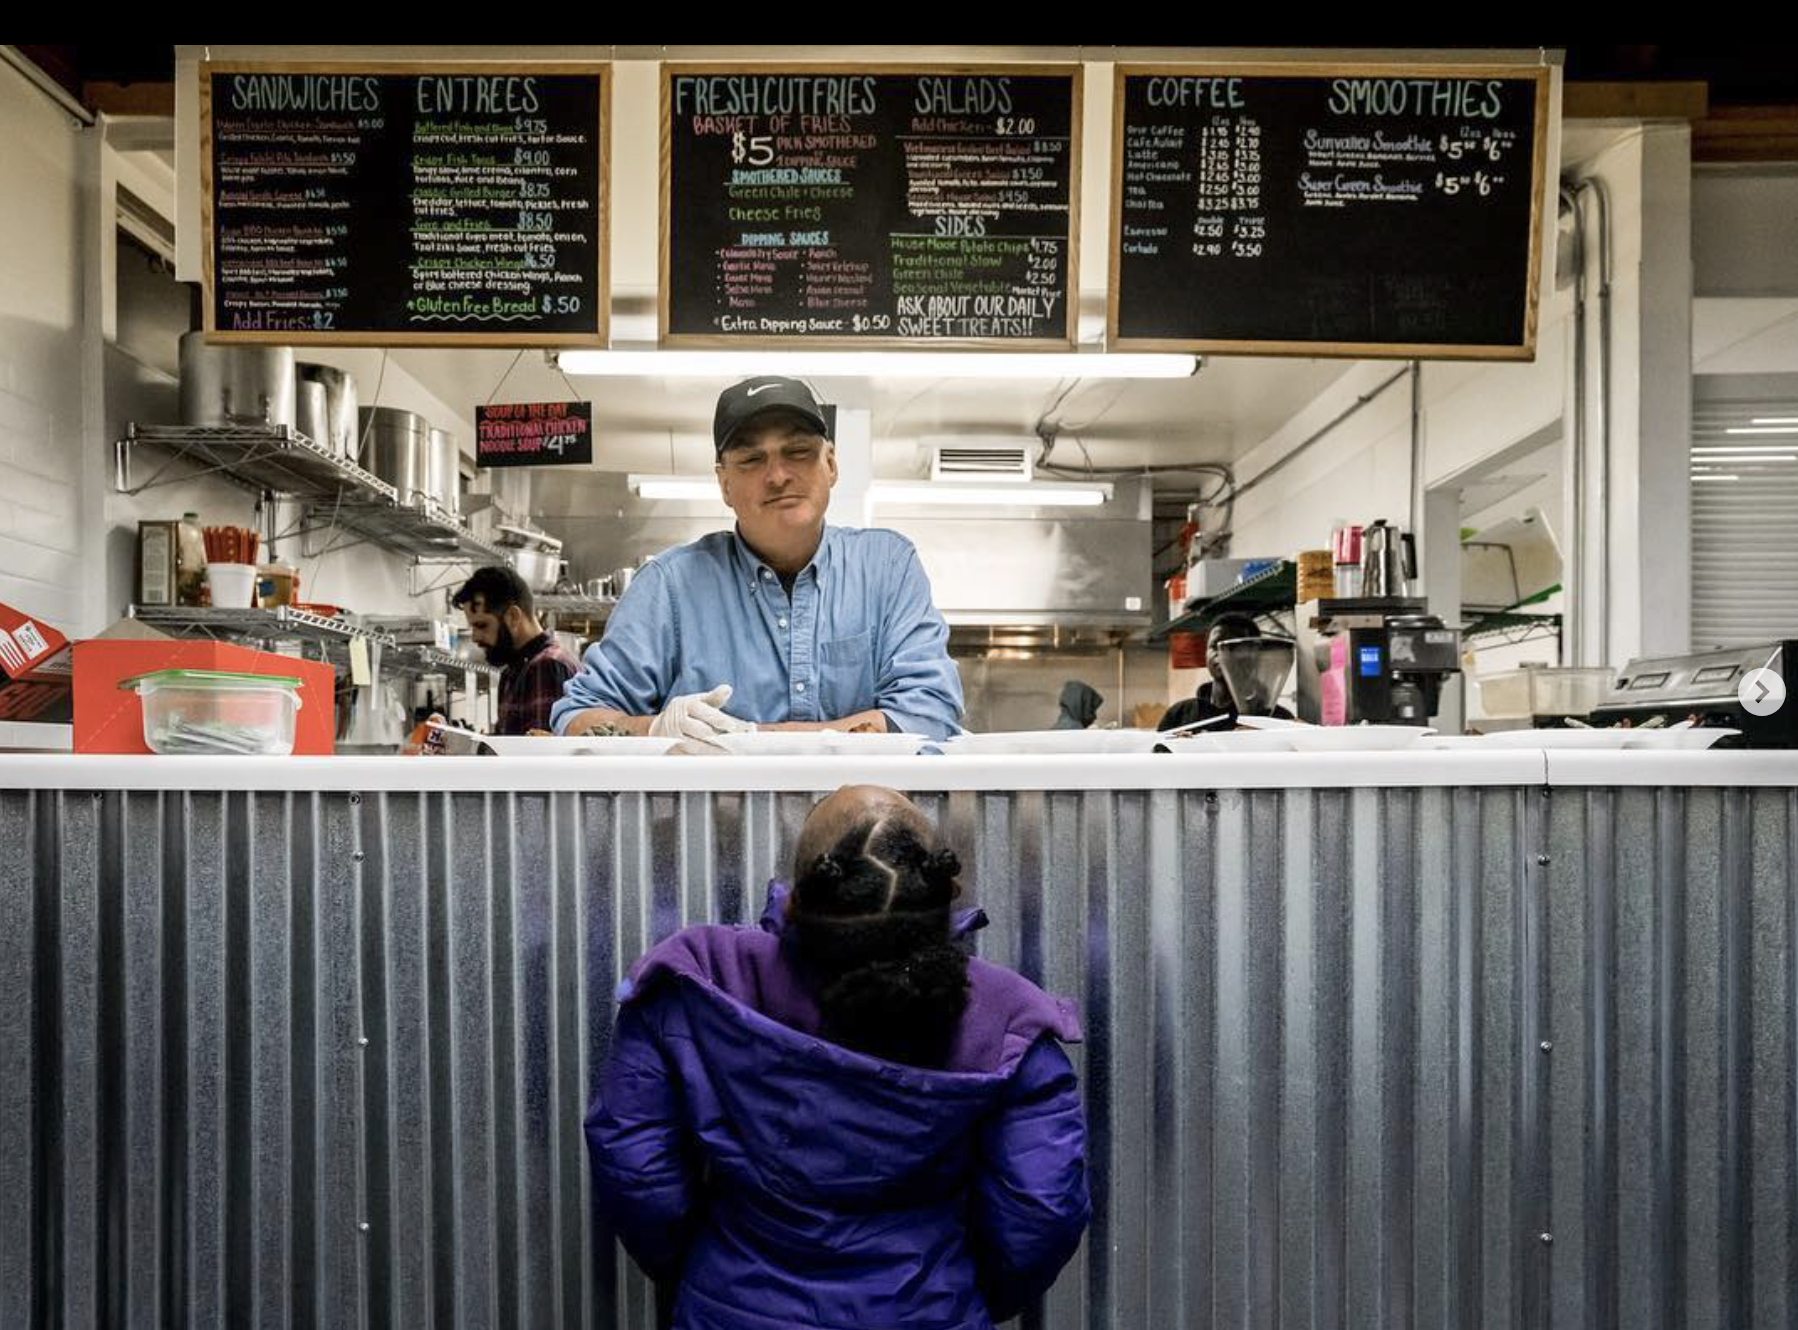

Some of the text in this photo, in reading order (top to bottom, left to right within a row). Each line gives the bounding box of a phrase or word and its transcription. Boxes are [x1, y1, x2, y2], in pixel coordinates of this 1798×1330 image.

[232, 75, 379, 111] SANDWICHES
[418, 76, 539, 113] ENTREES
[675, 77, 759, 115] FRESH
[914, 77, 1013, 114] SALADS
[1147, 77, 1245, 108] COFFEE
[1328, 79, 1503, 119] SMOOTHIES
[514, 116, 547, 134] $9.75
[693, 114, 851, 135] BASKET OF FRIES
[911, 117, 934, 132] Add
[995, 117, 1036, 135] $2.00
[732, 131, 774, 166] $5
[804, 135, 877, 149] SMOTHERED
[1373, 130, 1432, 152] Smoothie
[514, 148, 550, 165] $9.00
[555, 167, 577, 175] corn
[732, 167, 841, 184] SMOTHERED SAUCES
[519, 183, 550, 198] $8.75
[729, 186, 768, 199] Green
[1200, 183, 1229, 195] $2.50
[1197, 198, 1229, 210] $3.25
[517, 211, 553, 230] $8.50
[935, 216, 985, 236] SIDES
[741, 231, 829, 245] DIPPING SAUCES
[1193, 224, 1223, 238] $2.50
[1233, 224, 1265, 238] $3.25
[891, 239, 926, 249] House
[997, 241, 1030, 254] Chips
[1030, 237, 1058, 254] $1.75
[1232, 240, 1262, 257] $3.50
[893, 254, 1057, 269] Traditional Slaw $2.00
[413, 282, 424, 290] or
[449, 280, 482, 289] cheese
[893, 268, 931, 279] Green
[1026, 271, 1056, 284] $2.50
[893, 282, 948, 294] Seasonal
[417, 294, 580, 314] Gluten Free Bread $.50
[897, 295, 1055, 318] ASK ABOUT OUR DAILY
[233, 312, 261, 329] Add
[313, 311, 335, 330] $2
[721, 314, 891, 333] Extra Dipping Sauce $0.50
[897, 317, 1033, 336] SWEET TREATS!!
[479, 419, 587, 439] TRADITIONAL CHICKEN
